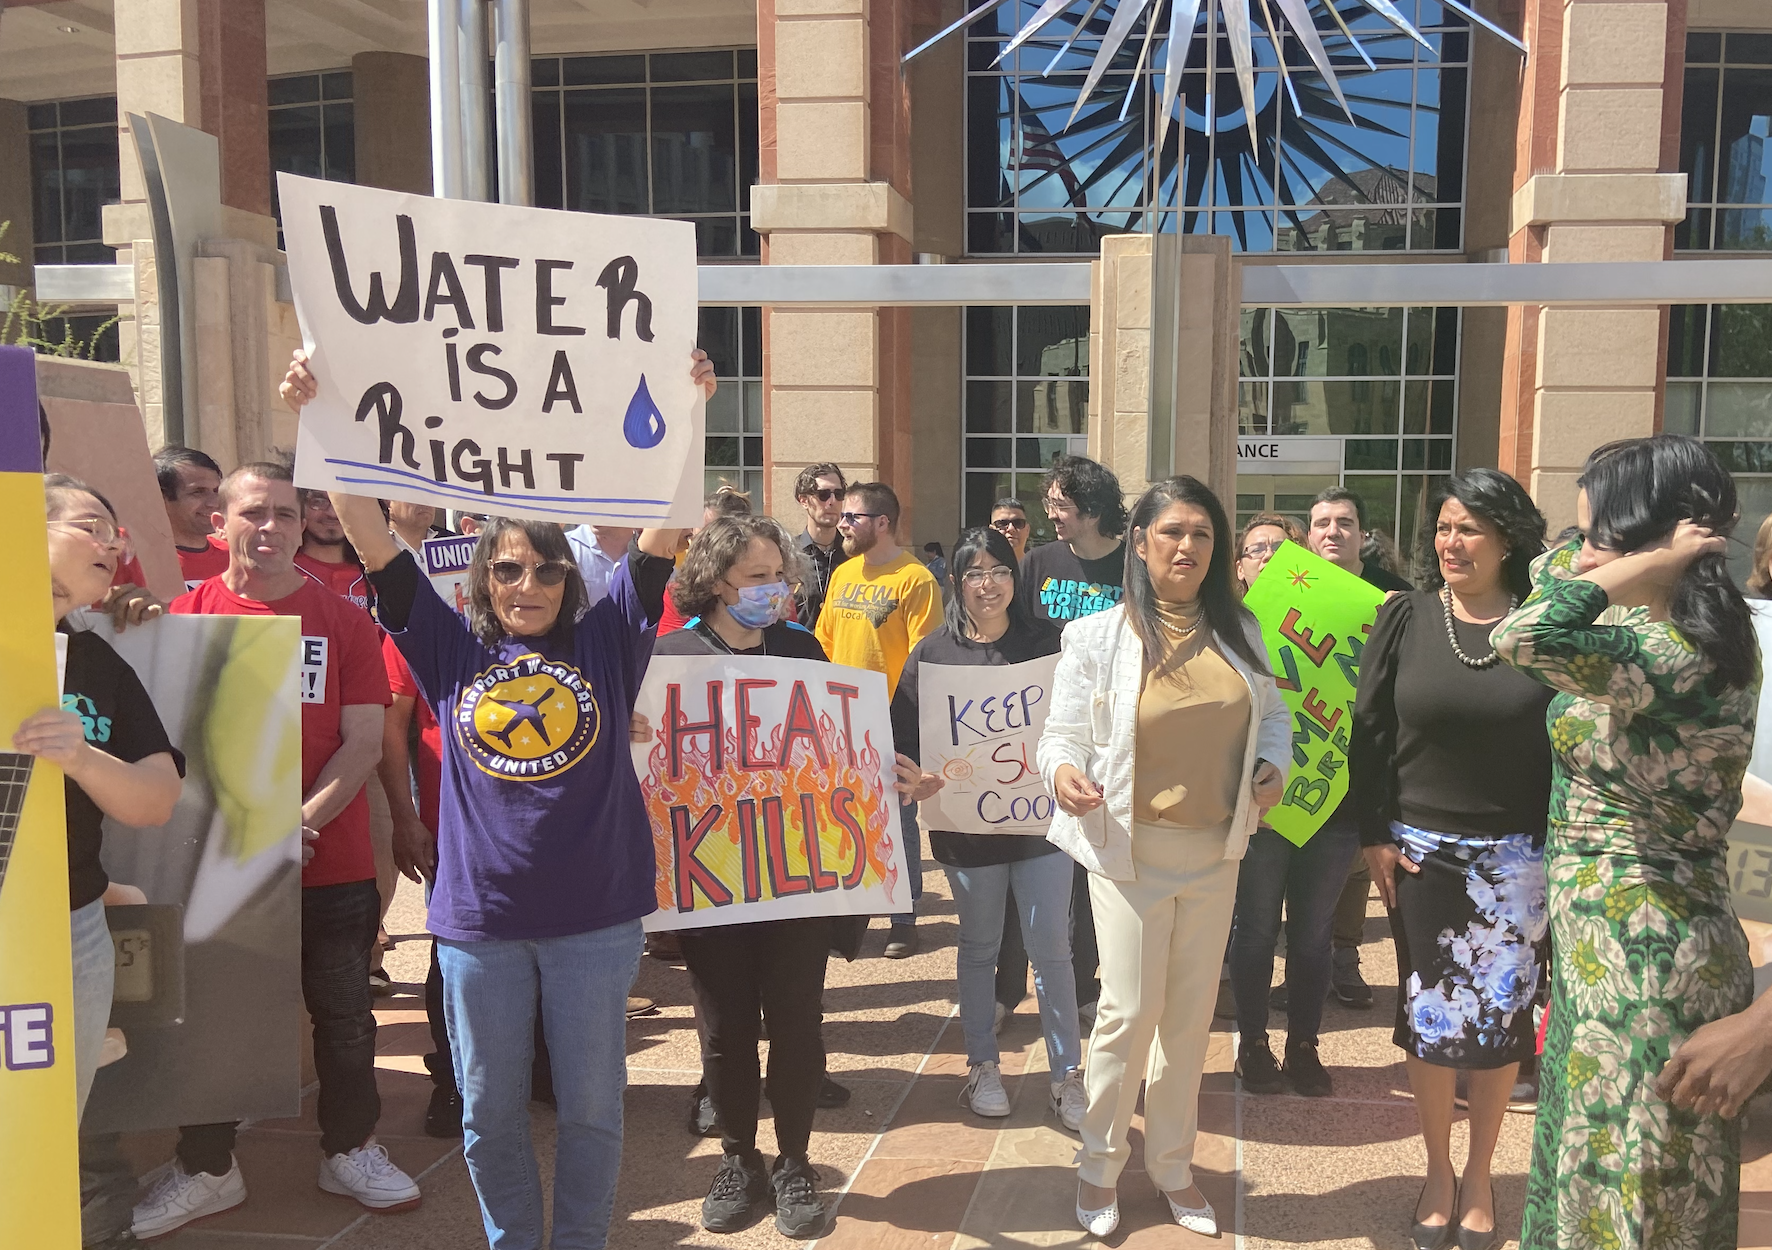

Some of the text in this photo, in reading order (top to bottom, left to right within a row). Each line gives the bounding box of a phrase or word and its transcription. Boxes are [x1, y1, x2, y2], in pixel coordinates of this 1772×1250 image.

[318, 204, 656, 343] WATER
[541, 349, 583, 414] A
[430, 542, 478, 569] UNIO
[841, 582, 894, 607] UFCW
[841, 609, 863, 621] Local
[1046, 578, 1124, 600] AIRPORT
[459, 658, 594, 723] AIRPORT WORKERS
[947, 684, 1044, 746] KEEP
[489, 750, 569, 775] UNITED
[664, 679, 860, 783] HEAT
[669, 787, 867, 914] KILLS
[0, 1003, 54, 1071] E
